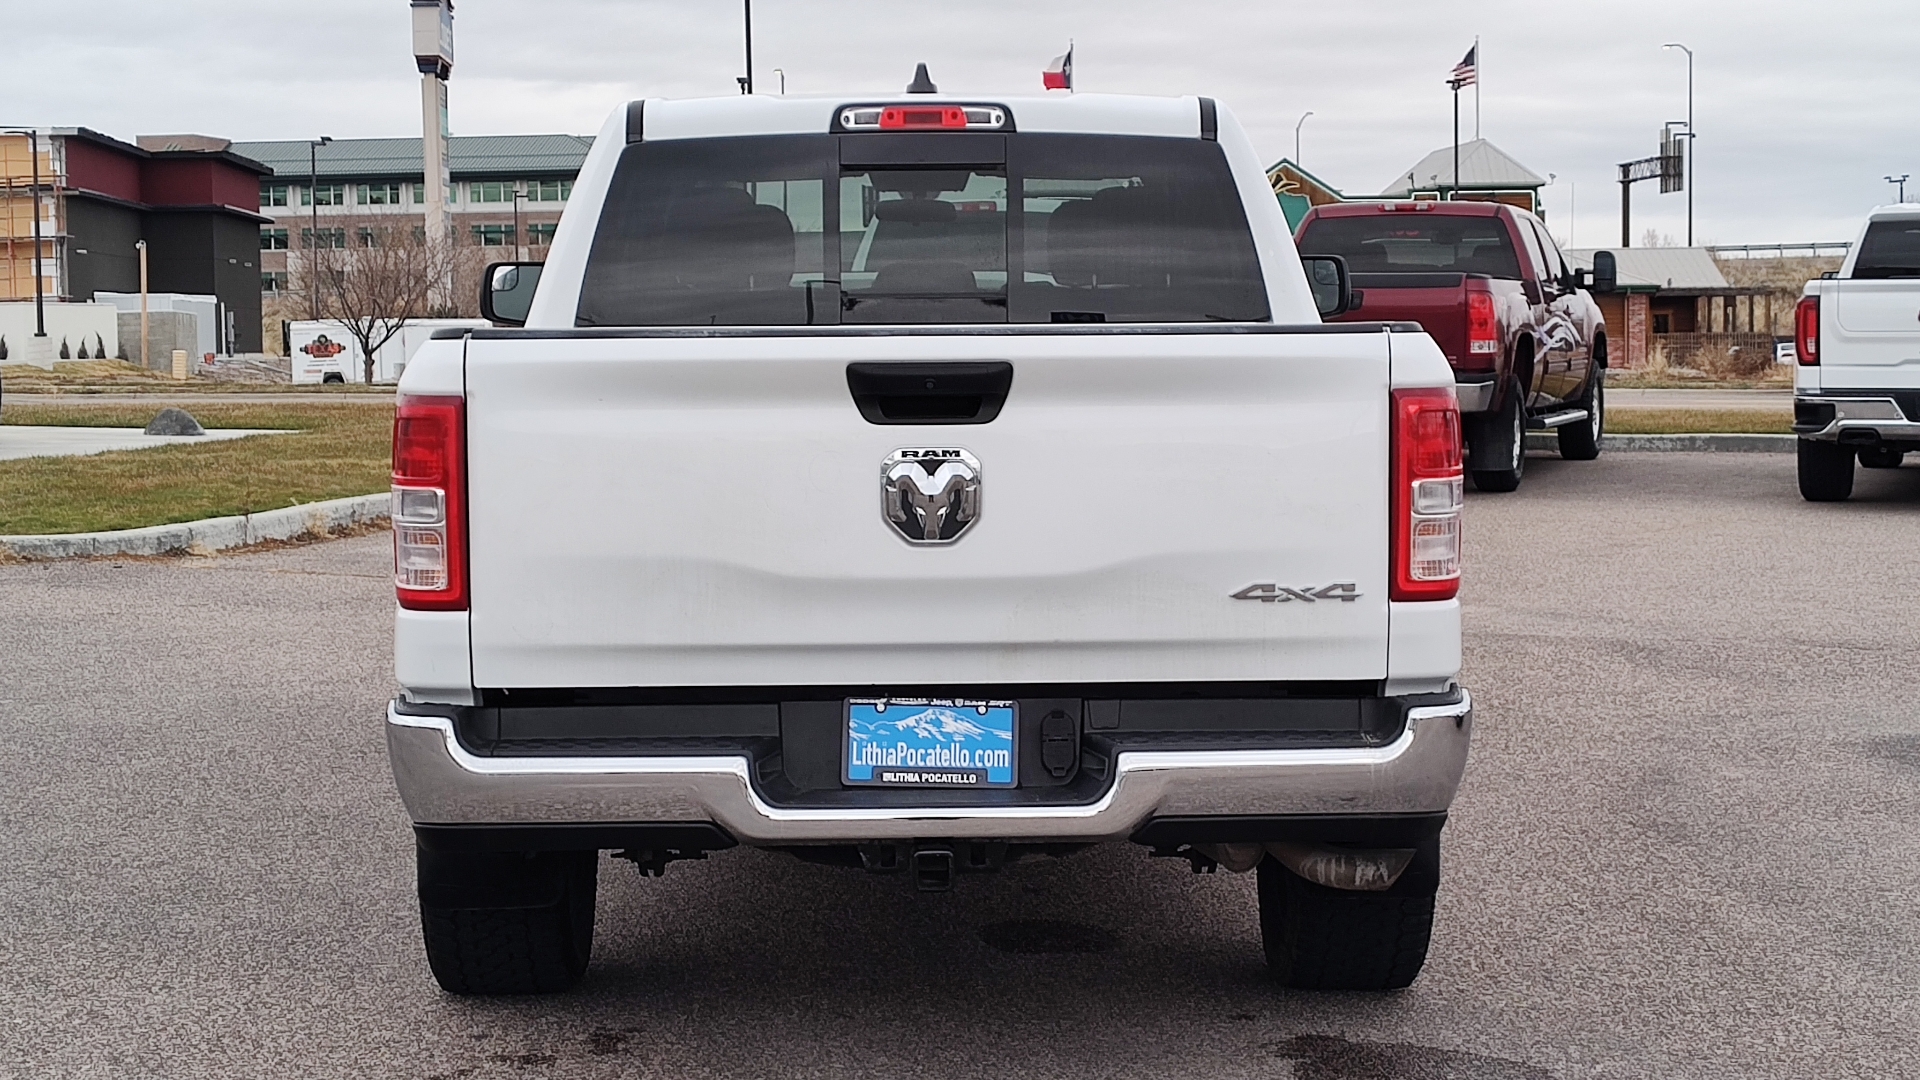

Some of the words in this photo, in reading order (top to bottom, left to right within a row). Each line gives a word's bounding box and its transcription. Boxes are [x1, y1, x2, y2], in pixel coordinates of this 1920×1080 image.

[901, 449, 961, 458] RAM
[1228, 583, 1364, 602] 4x4
[852, 741, 1009, 767] LithiaPocatello.com
[892, 772, 920, 782] LITHIA
[921, 773, 977, 784] POCATELLO
